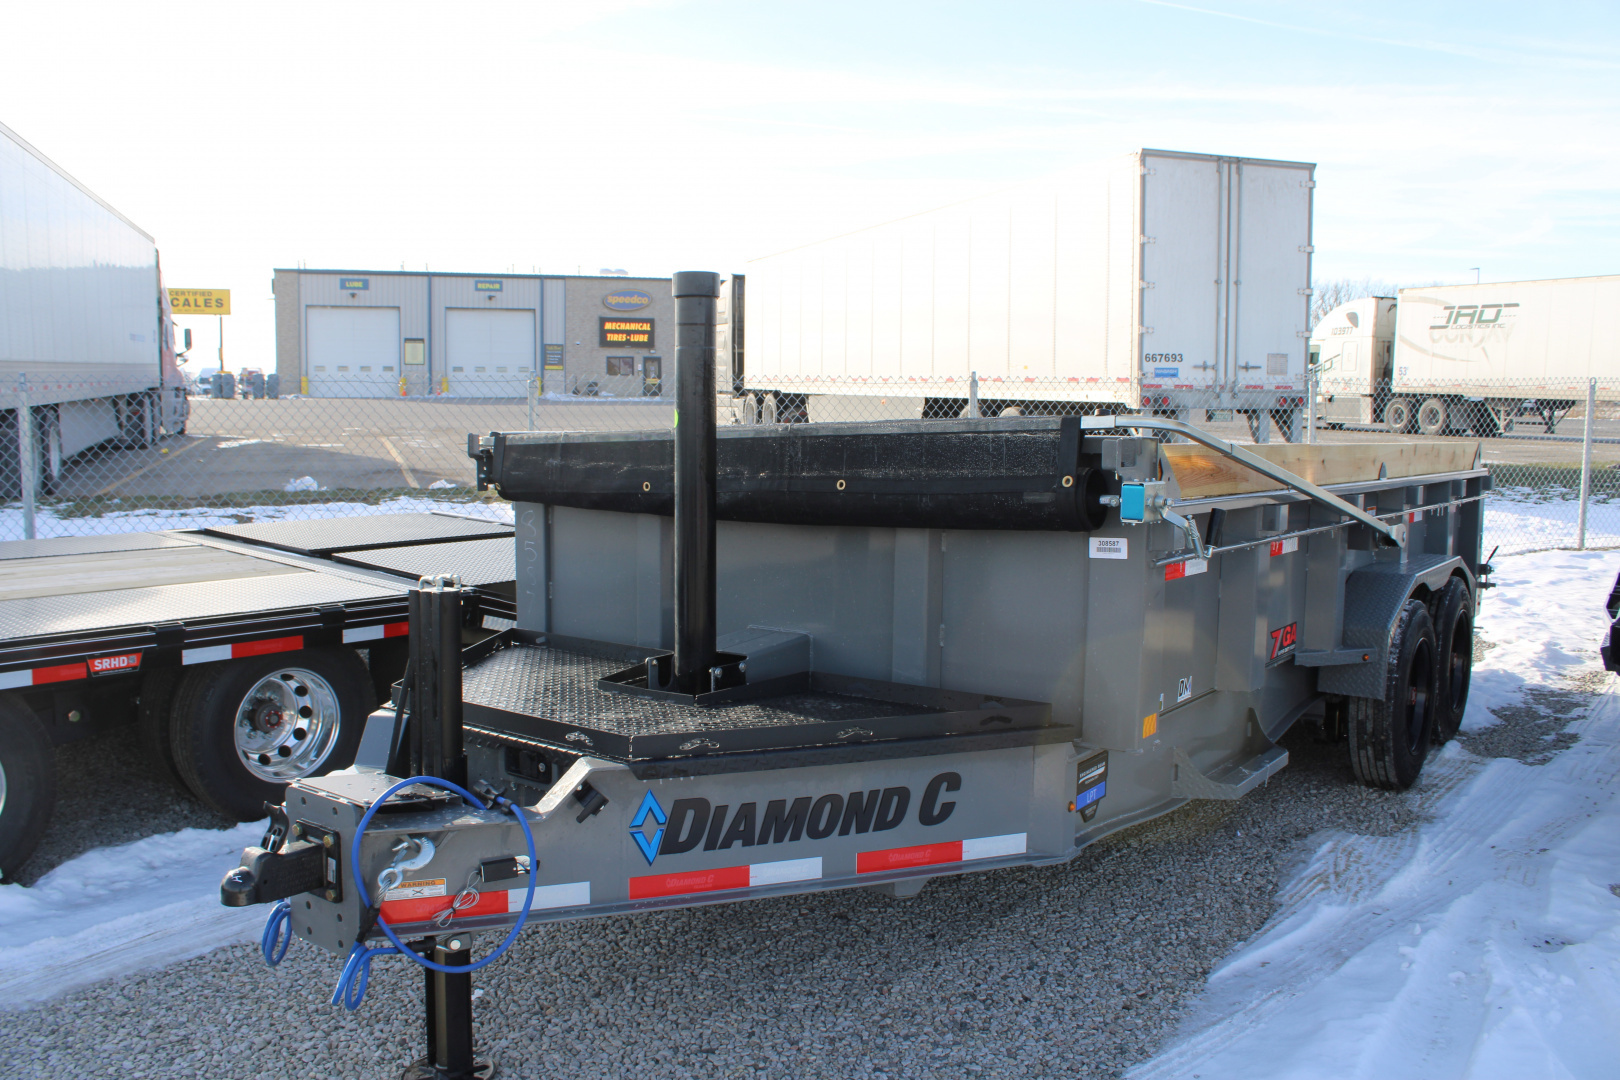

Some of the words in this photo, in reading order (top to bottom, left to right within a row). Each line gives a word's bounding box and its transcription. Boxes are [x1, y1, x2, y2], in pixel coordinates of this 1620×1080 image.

[170, 297, 224, 308] CALES
[607, 295, 649, 305] speedco
[604, 321, 651, 331] MECHANICAL
[1144, 353, 1183, 363] 667693
[94, 656, 128, 670] SRHD
[1086, 788, 1097, 803] LPT
[659, 786, 911, 856] DIAMOND
[919, 771, 962, 826] C
[401, 880, 436, 888] WARNING
